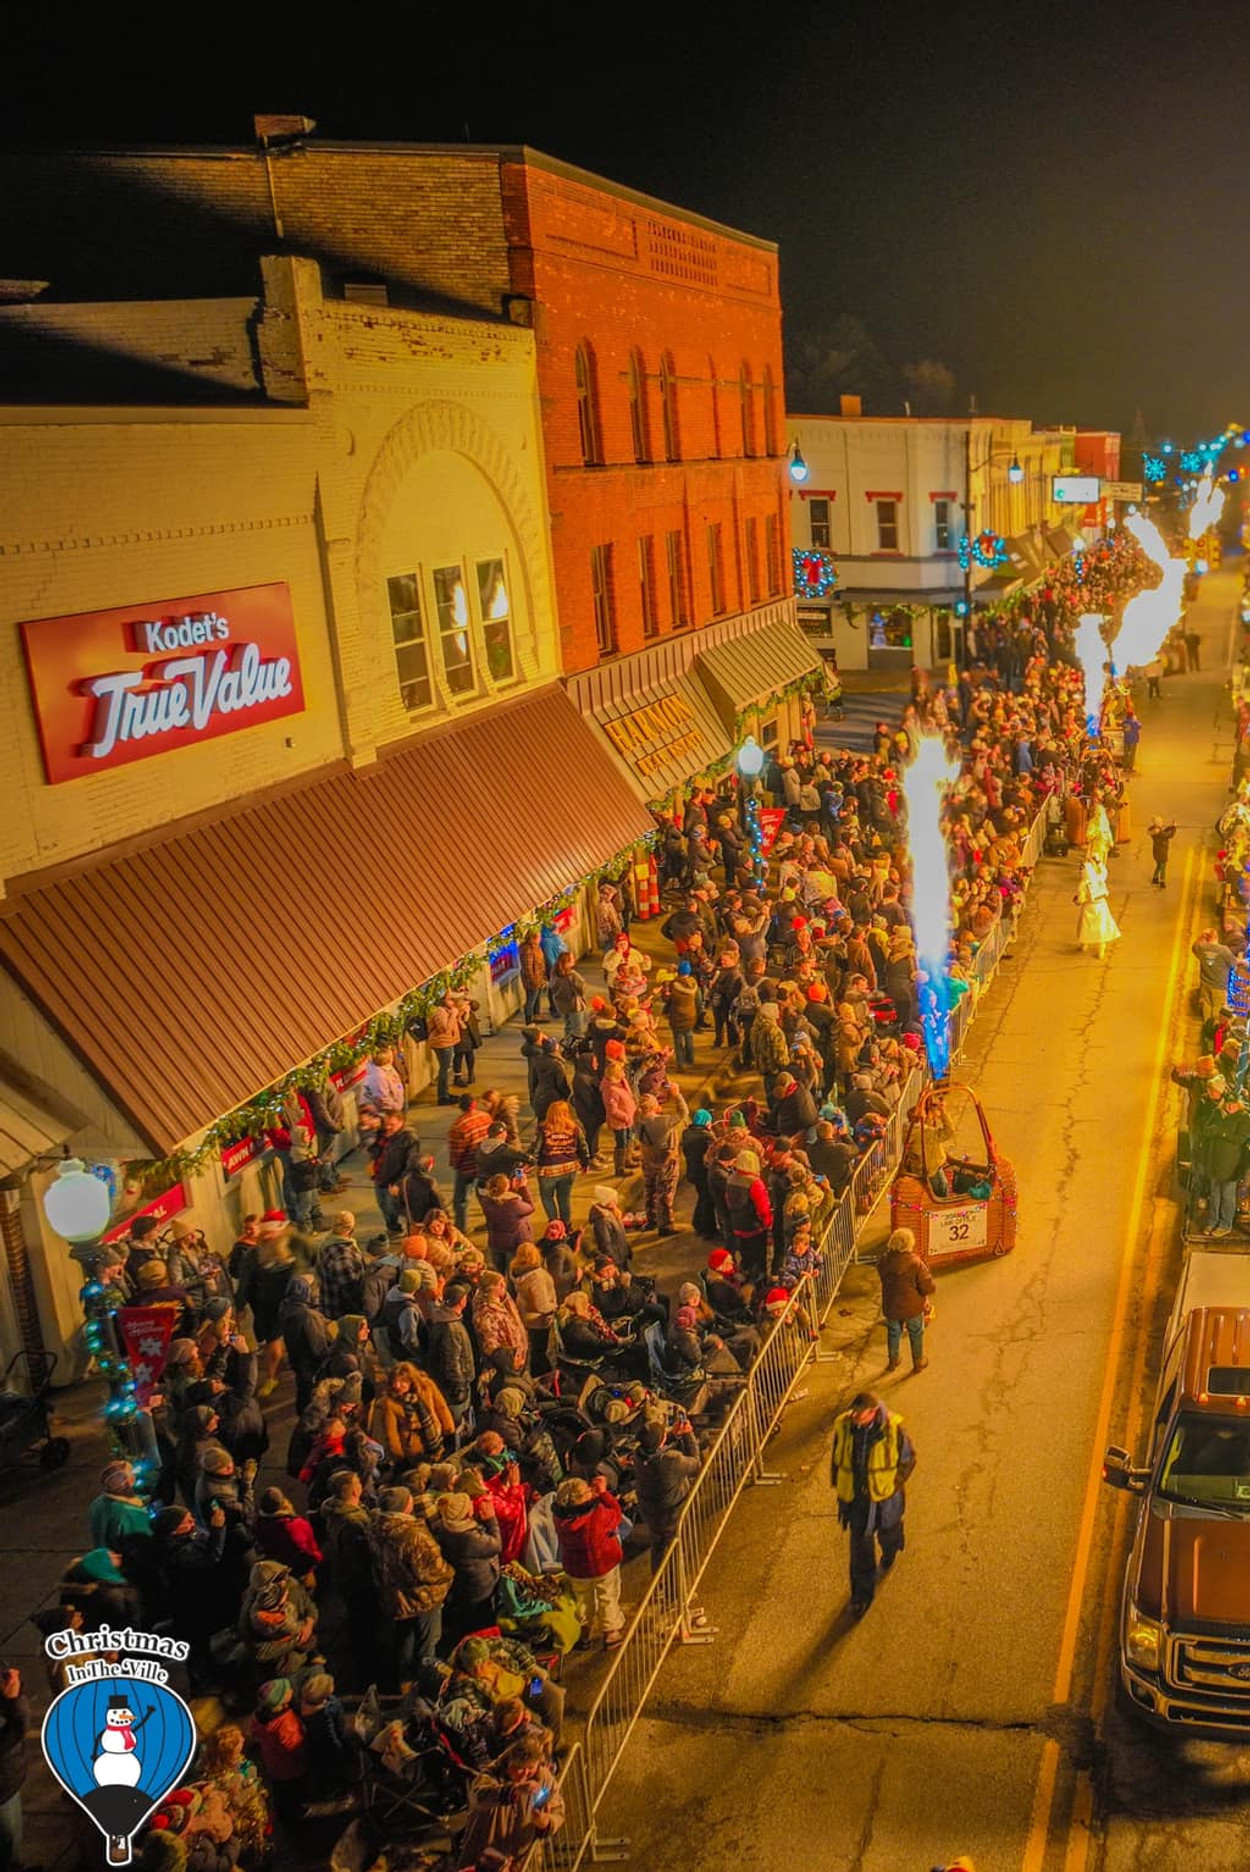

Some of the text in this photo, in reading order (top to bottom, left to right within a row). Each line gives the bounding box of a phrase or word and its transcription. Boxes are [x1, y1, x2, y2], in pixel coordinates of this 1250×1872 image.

[145, 612, 230, 653] Kodet's
[92, 643, 293, 759] True Value
[949, 1224, 969, 1241] 32
